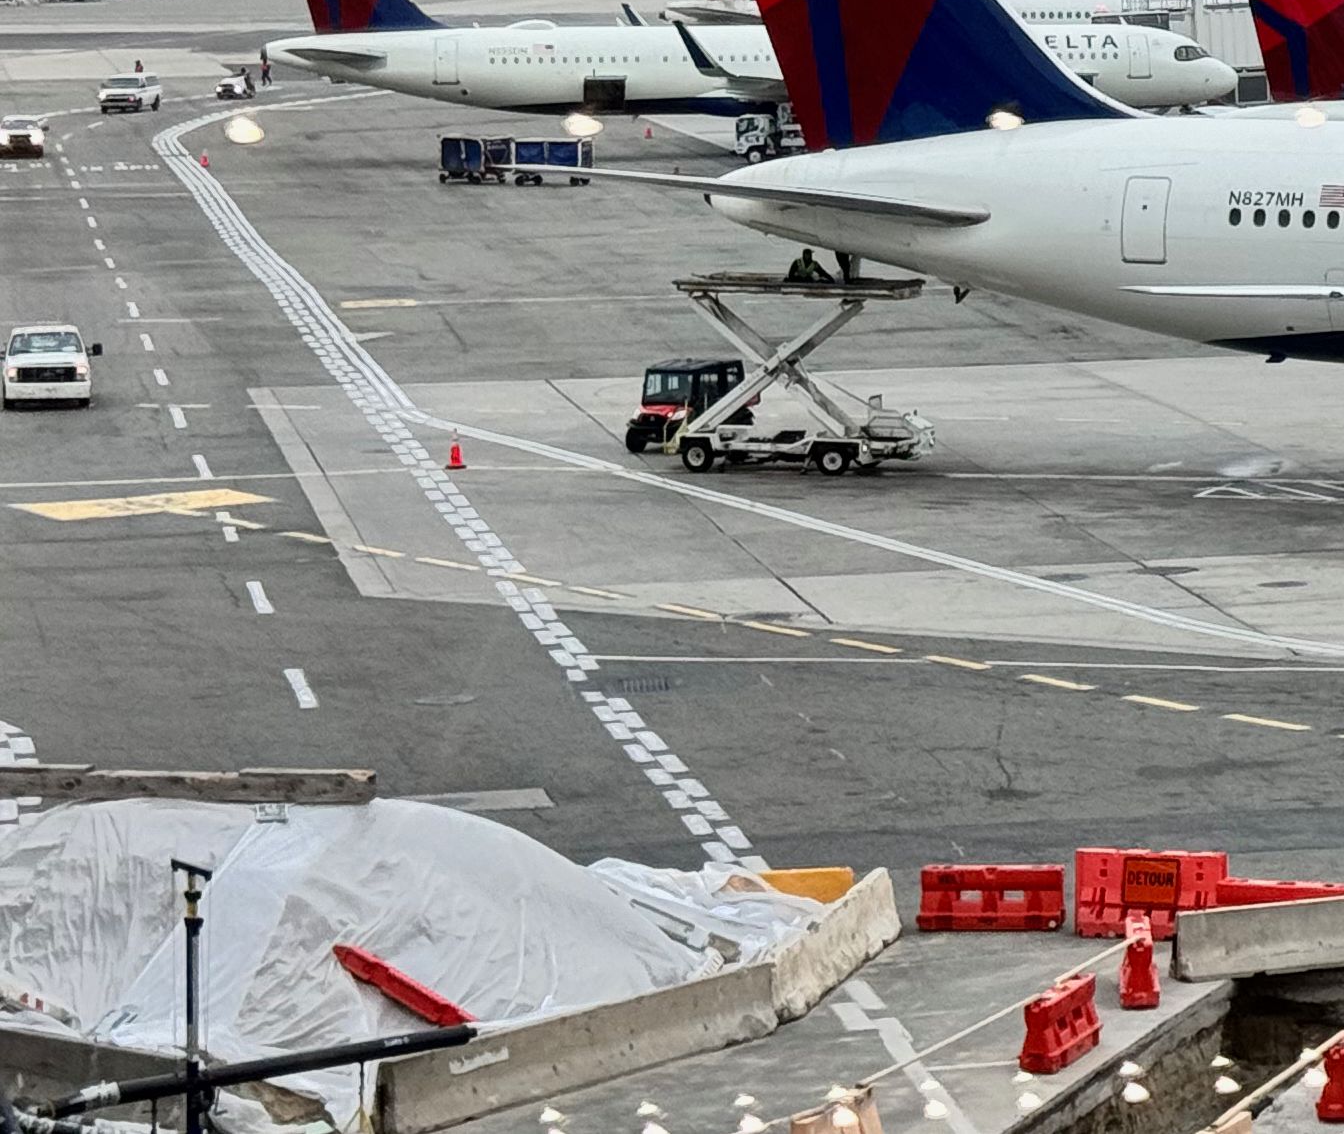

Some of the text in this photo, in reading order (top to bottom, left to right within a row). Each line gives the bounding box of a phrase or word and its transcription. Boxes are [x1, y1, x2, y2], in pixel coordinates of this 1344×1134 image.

[1045, 35, 1118, 48] ELTA
[1229, 190, 1304, 206] N827MH
[1127, 870, 1174, 887] DETOUR
